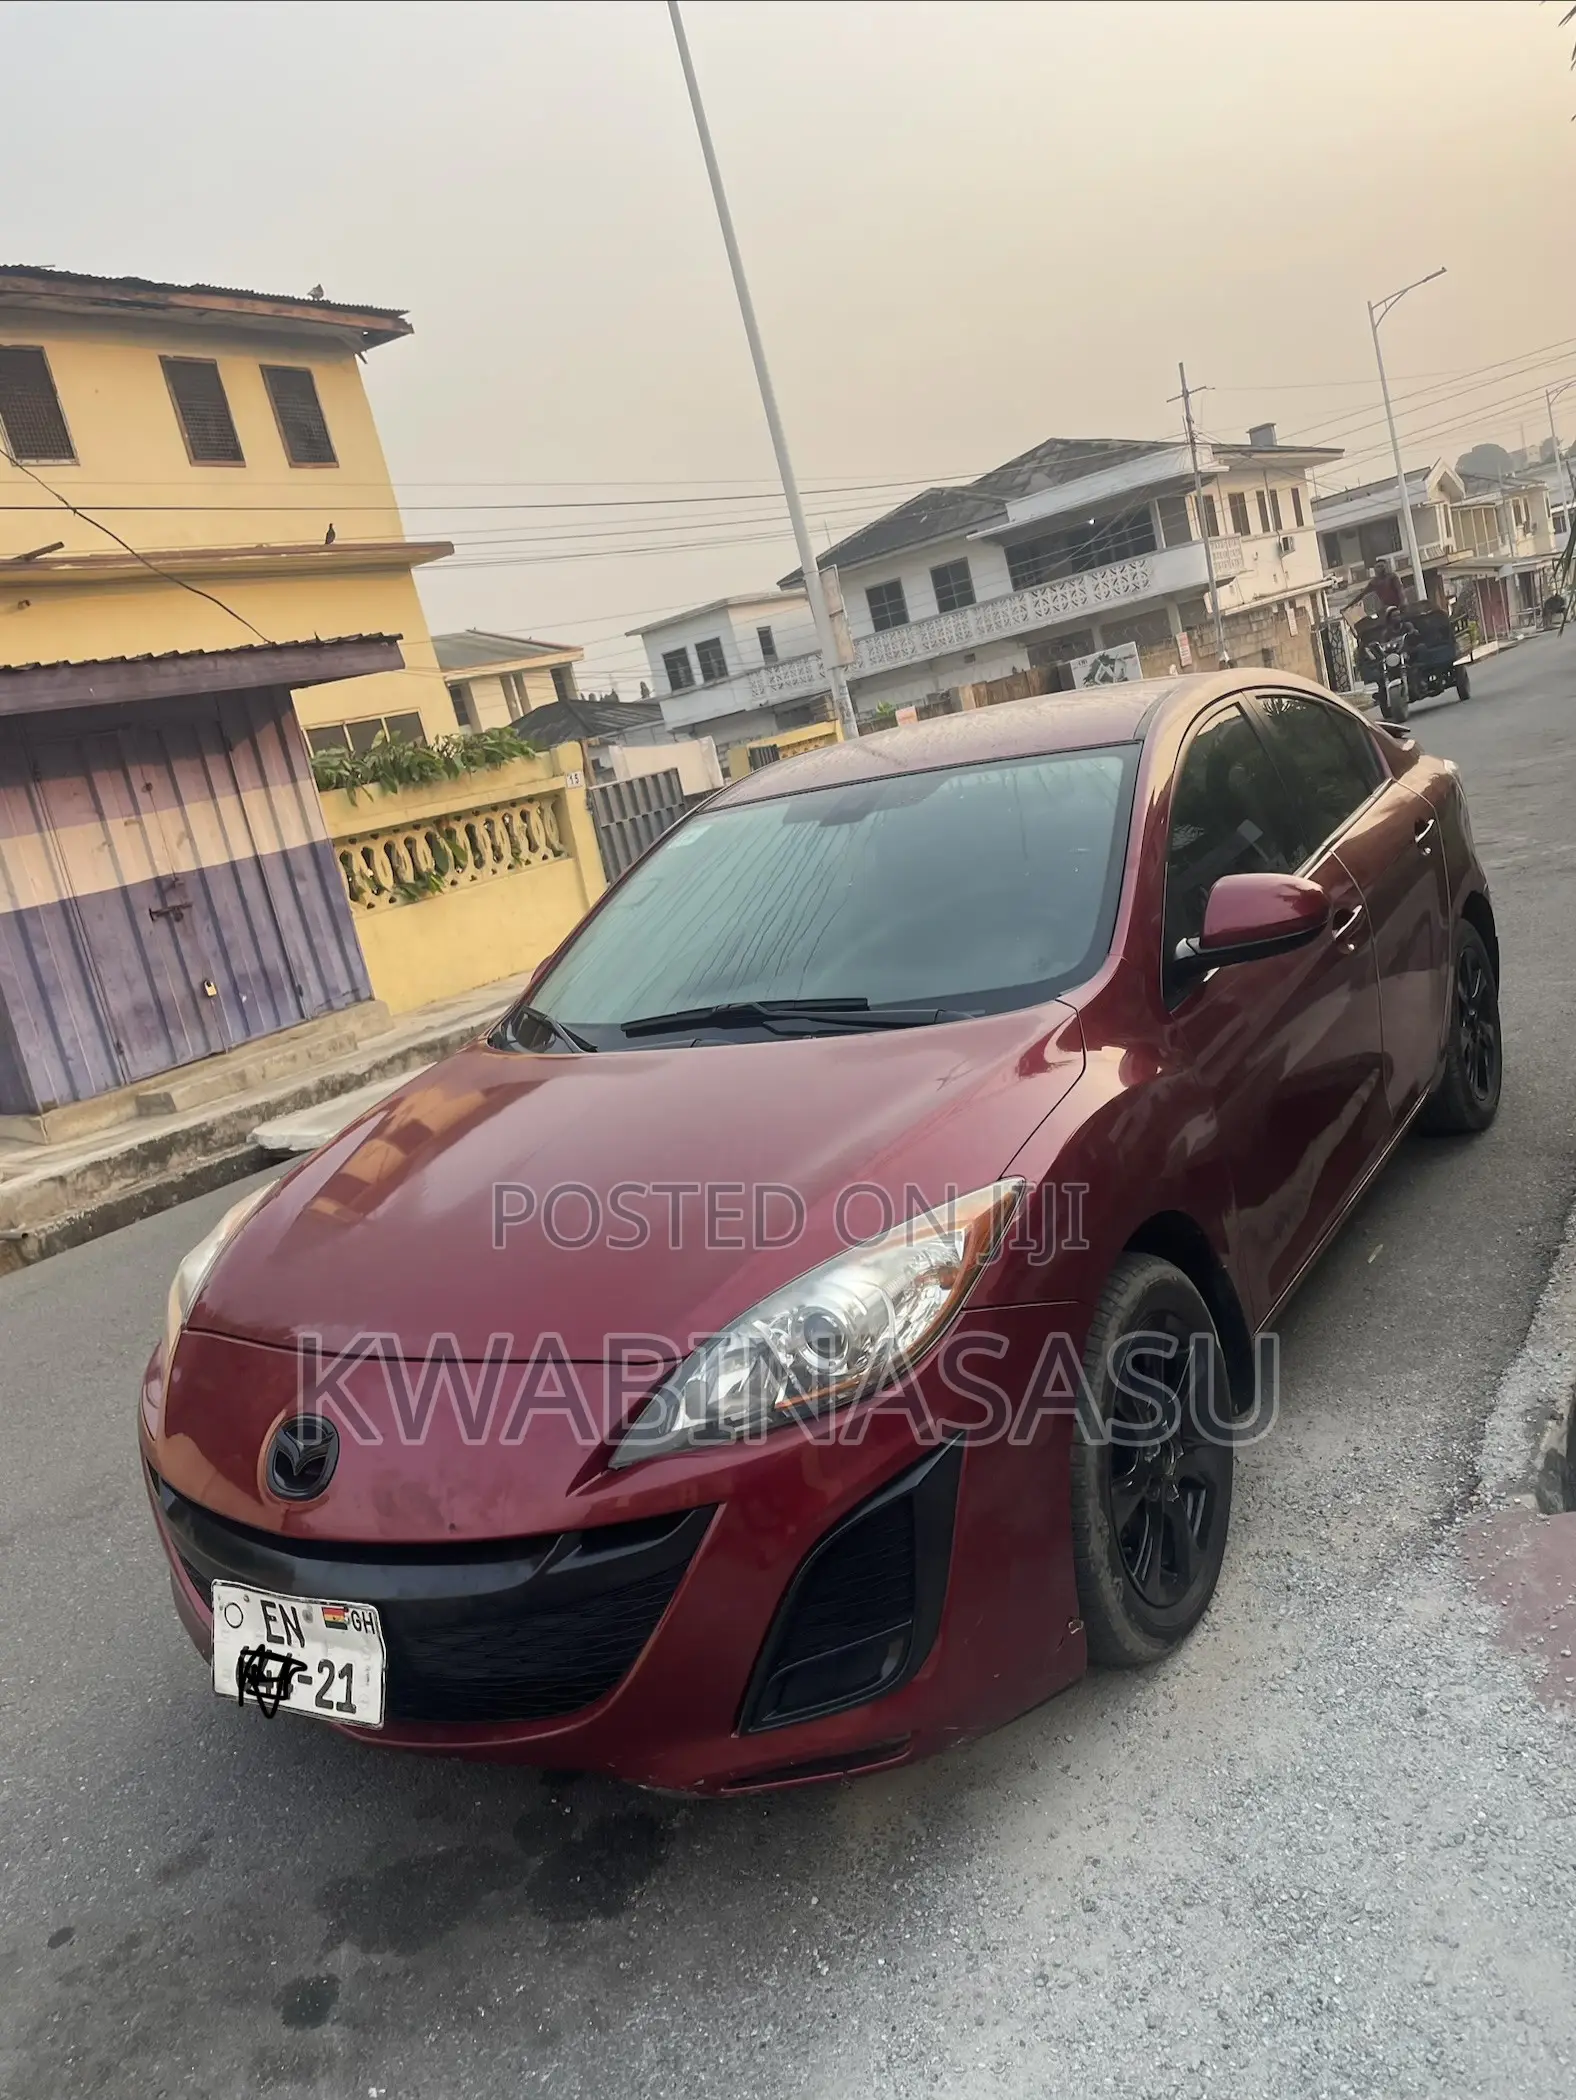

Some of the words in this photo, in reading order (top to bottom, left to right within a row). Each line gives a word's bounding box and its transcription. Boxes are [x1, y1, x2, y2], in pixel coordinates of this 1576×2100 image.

[568, 773, 580, 785] 15
[260, 1599, 306, 1649] EN
[351, 1609, 376, 1635] GH
